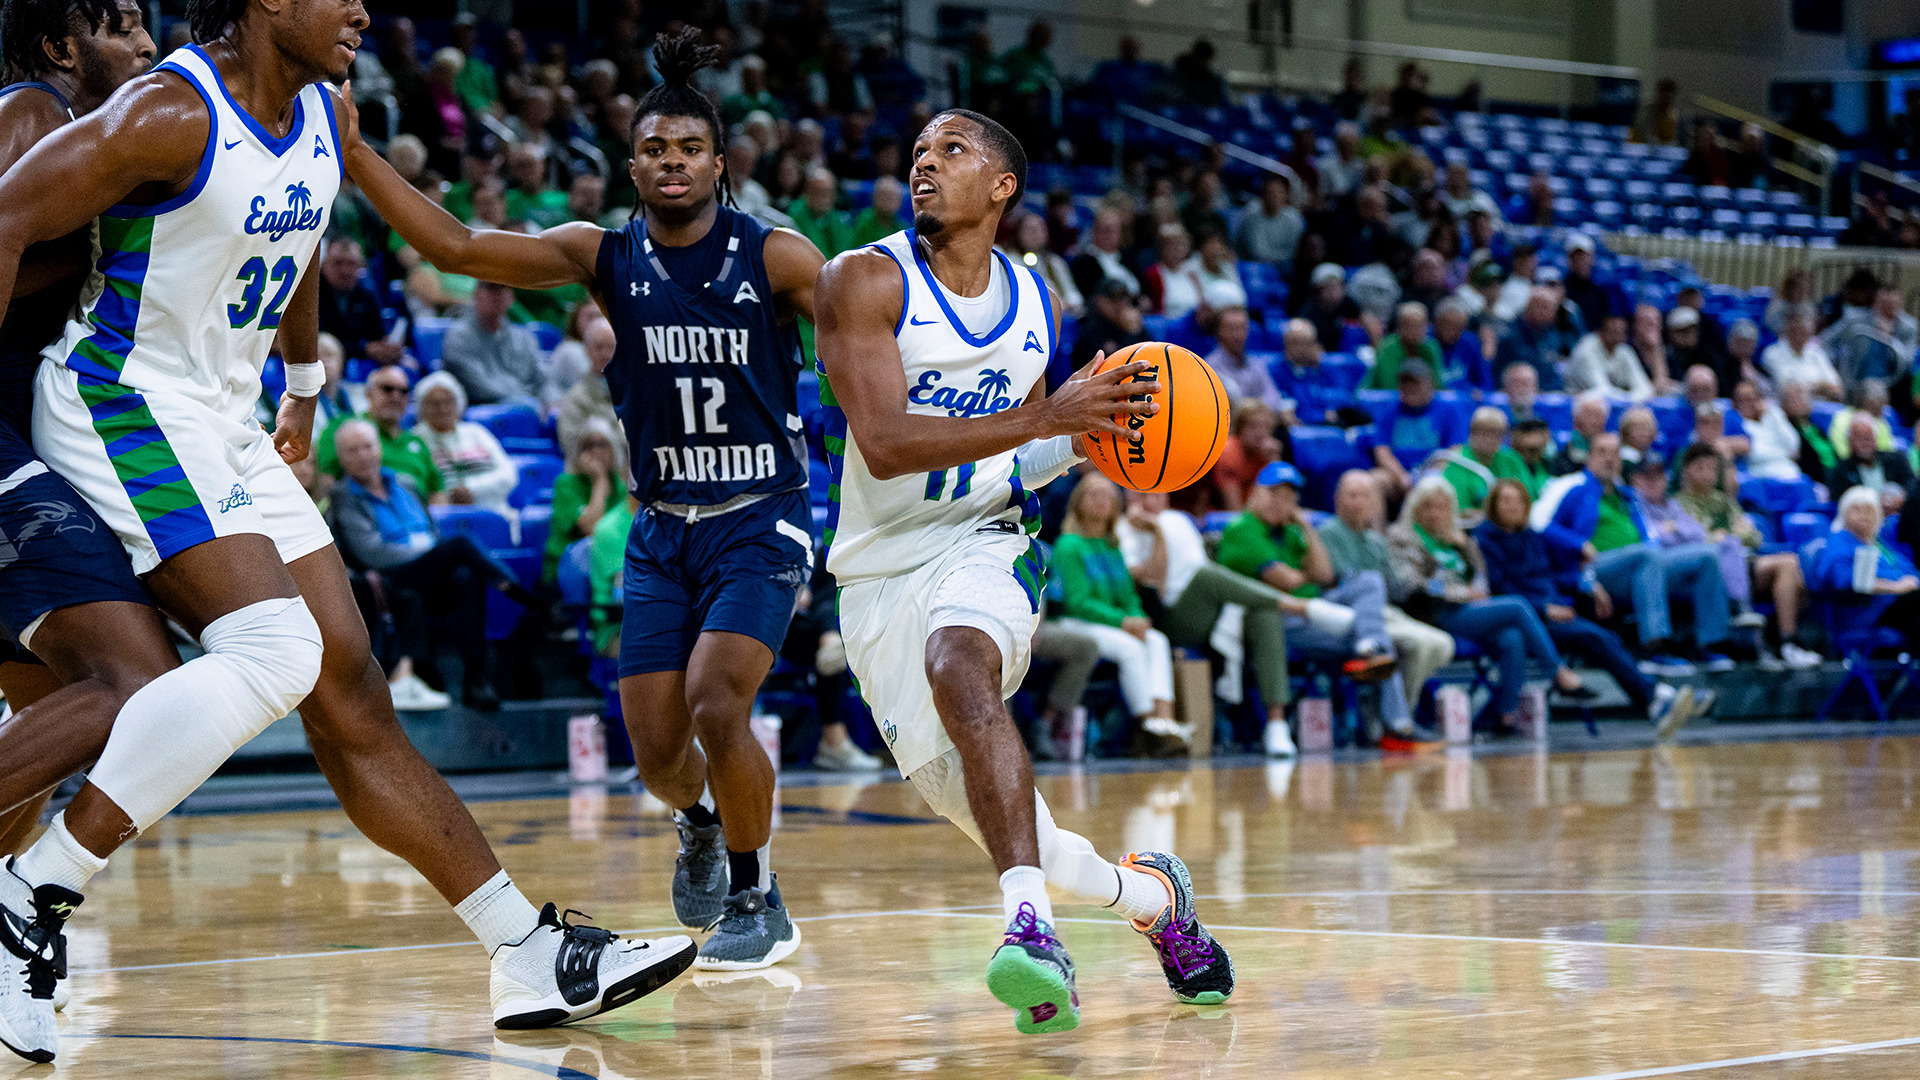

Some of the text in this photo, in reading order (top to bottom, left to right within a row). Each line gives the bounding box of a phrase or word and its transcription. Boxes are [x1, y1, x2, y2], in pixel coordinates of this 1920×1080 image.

[244, 181, 324, 243] Eagles
[227, 255, 299, 331] 32
[642, 325, 749, 365] NORTH
[675, 377, 729, 435] 12
[653, 443, 777, 482] FLORIDA
[217, 493, 253, 514] FGCU
